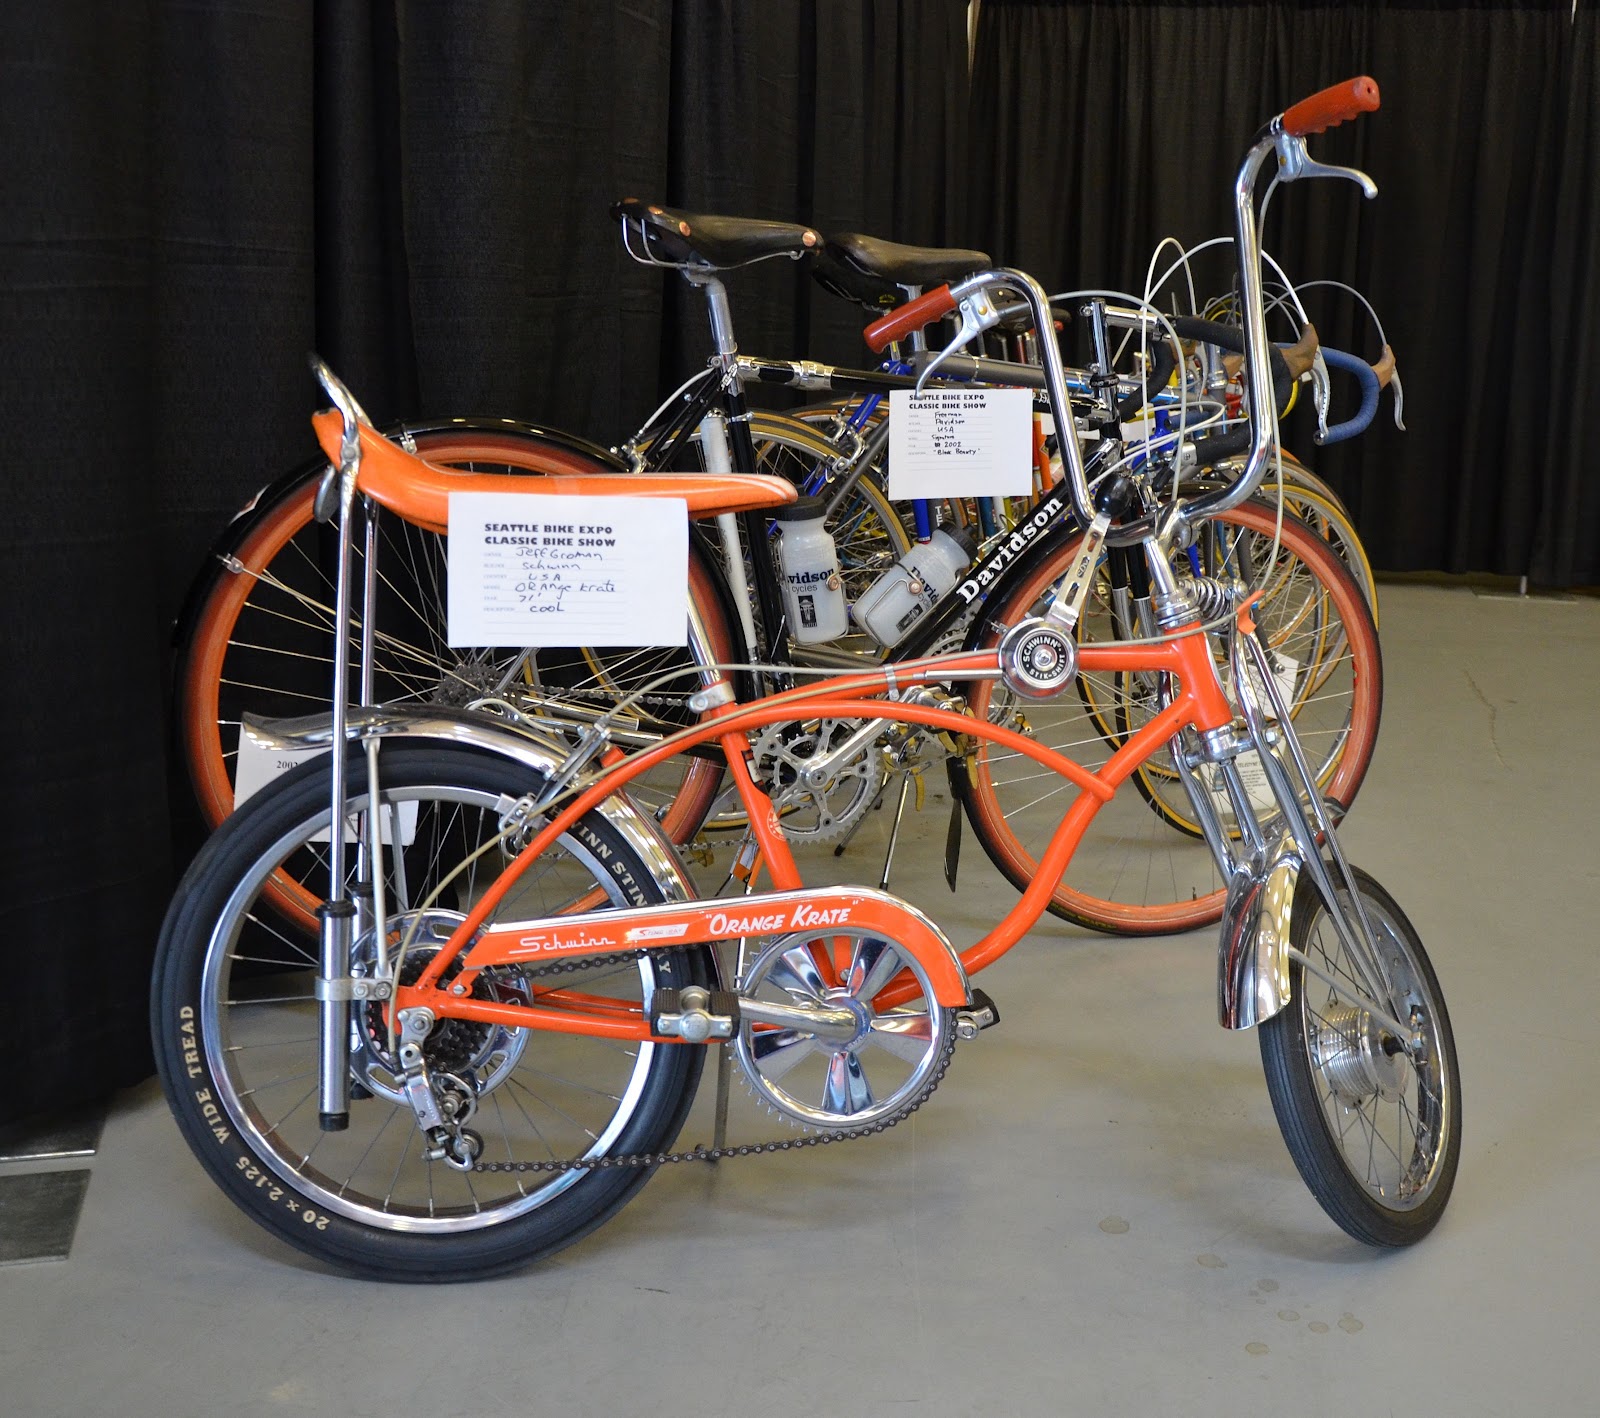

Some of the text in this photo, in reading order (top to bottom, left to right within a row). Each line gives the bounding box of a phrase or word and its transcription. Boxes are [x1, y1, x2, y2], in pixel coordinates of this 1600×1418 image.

[937, 426, 954, 434] USA
[484, 523, 613, 535] SEATTLE BIKE EXPO
[484, 536, 617, 547] CLASSIC BIKE SHOW
[956, 498, 1063, 604] Davidson
[791, 584, 818, 594] cycles
[1029, 653, 1066, 680] STIK-SHIFT
[508, 932, 617, 955] Schwinn
[180, 1005, 203, 1079] TREAD
[195, 1087, 231, 1145] WIDE
[235, 1156, 285, 1201] 2.125
[302, 1209, 331, 1231] 20
